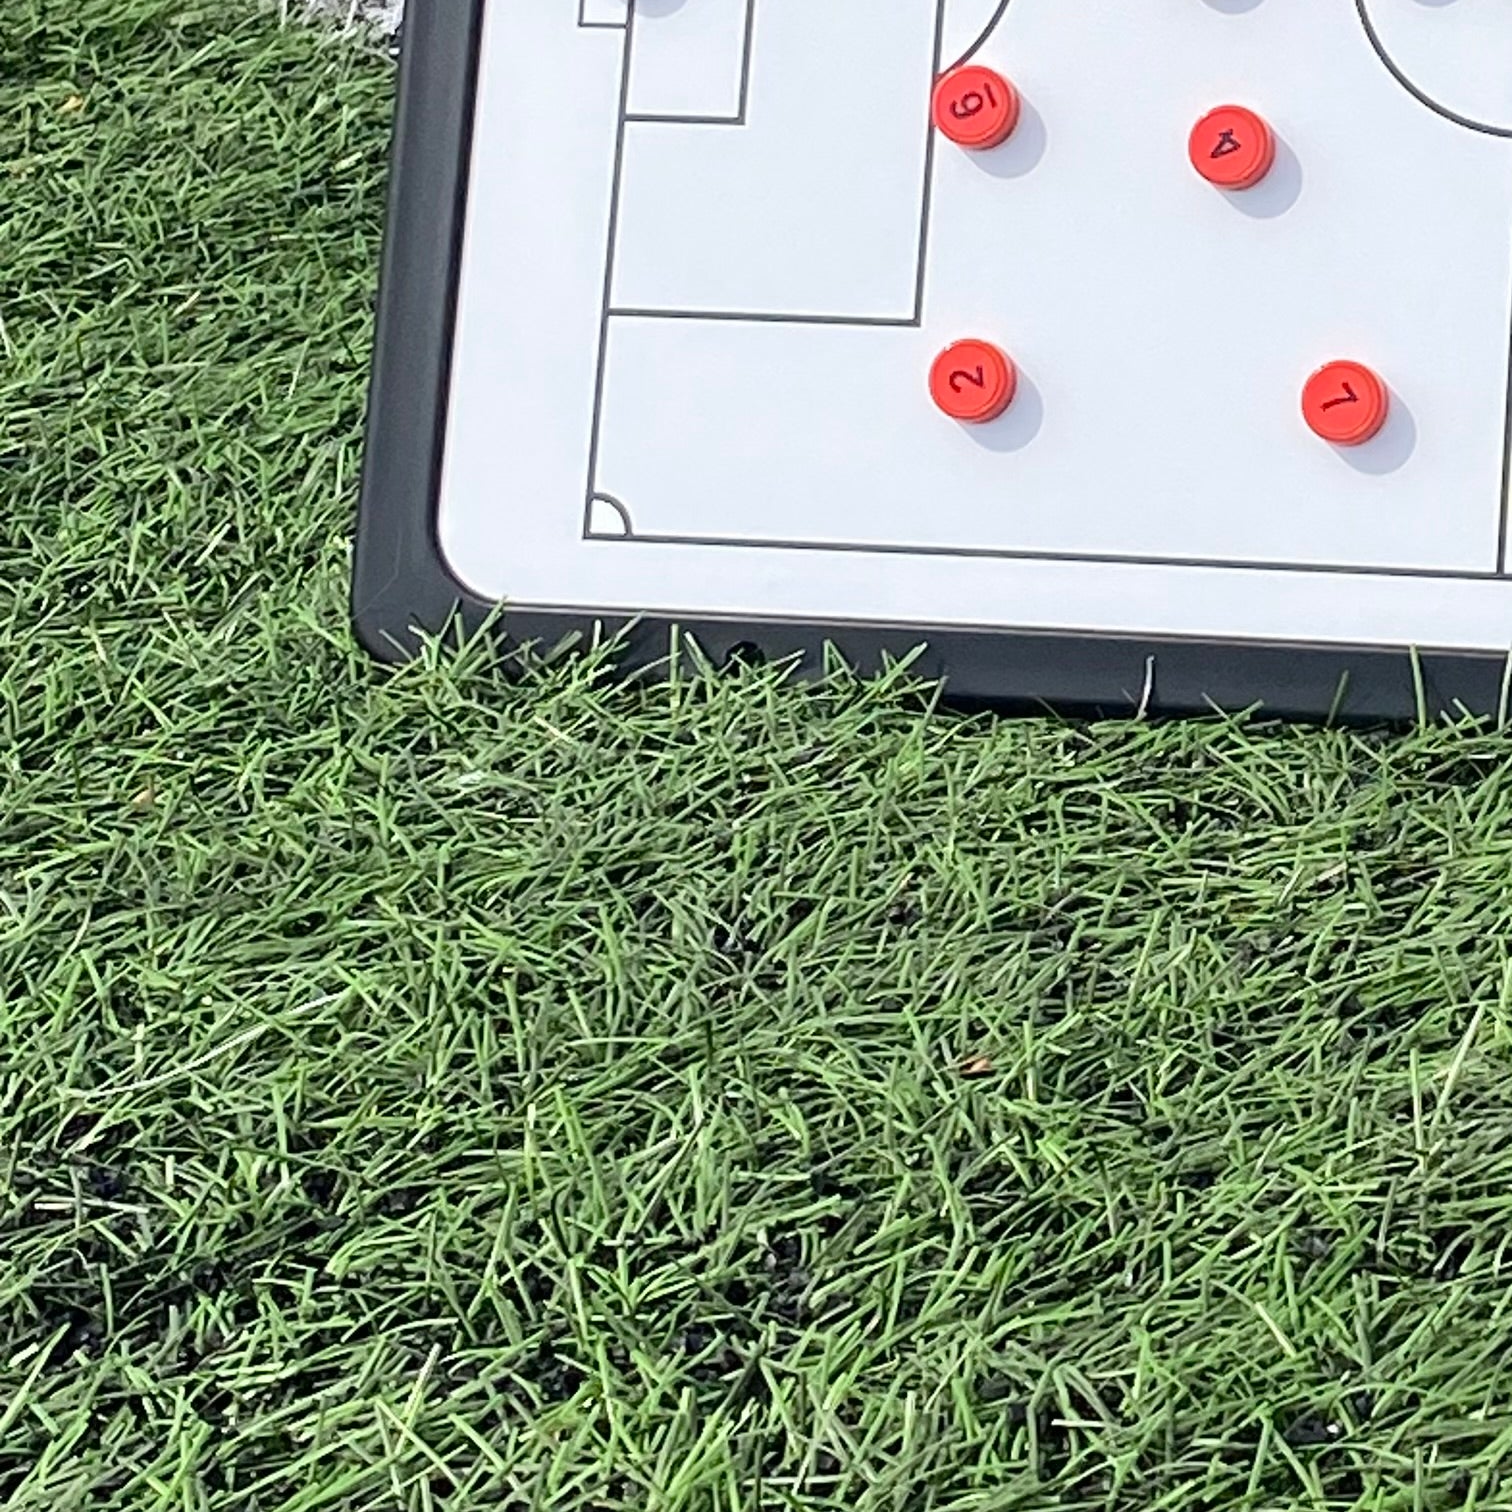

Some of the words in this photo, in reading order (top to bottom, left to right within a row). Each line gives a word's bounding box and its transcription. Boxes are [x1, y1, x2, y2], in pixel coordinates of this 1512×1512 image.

[1208, 127, 1243, 160] 4
[948, 364, 985, 394] 2
[1321, 381, 1360, 413] 7
